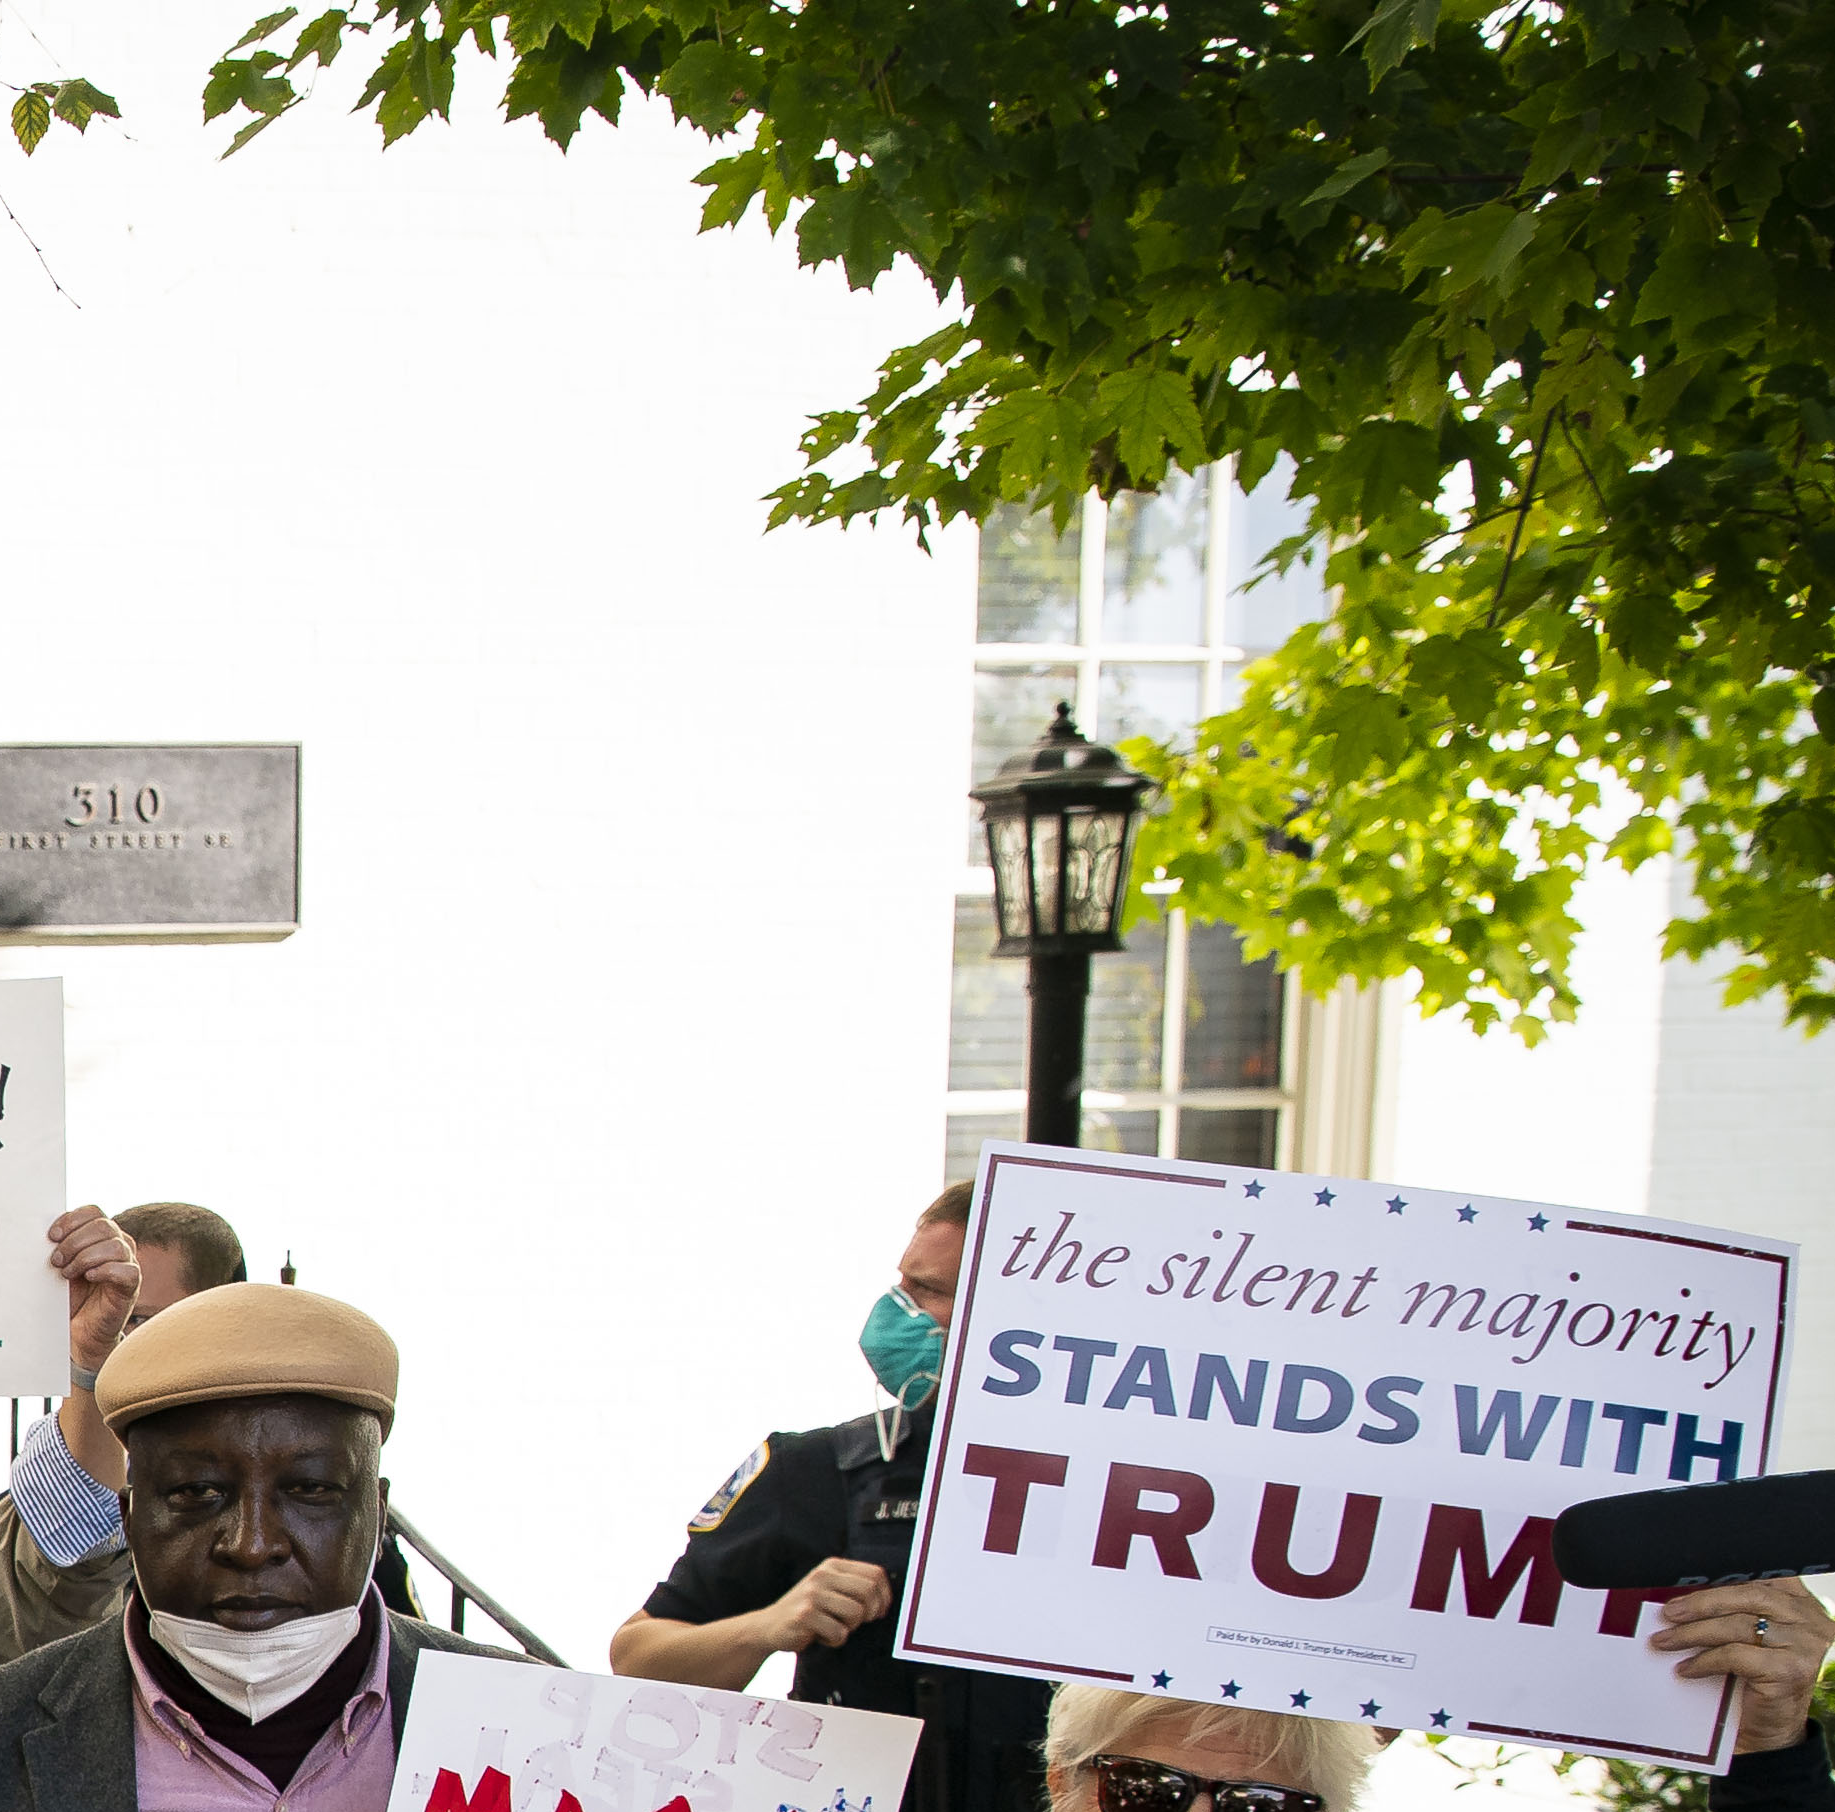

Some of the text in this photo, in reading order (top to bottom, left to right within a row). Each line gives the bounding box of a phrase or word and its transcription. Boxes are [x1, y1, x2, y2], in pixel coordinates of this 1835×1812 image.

[65, 782, 165, 828] 310
[89, 831, 187, 850] STREET
[1000, 1210, 1756, 1390] the silent majority
[981, 1328, 1744, 1484] STANDS WITH
[1215, 1630, 1235, 1641] Paid
[1236, 1632, 1249, 1643] for
[1249, 1634, 1261, 1646] by
[1262, 1636, 1293, 1649] Donald
